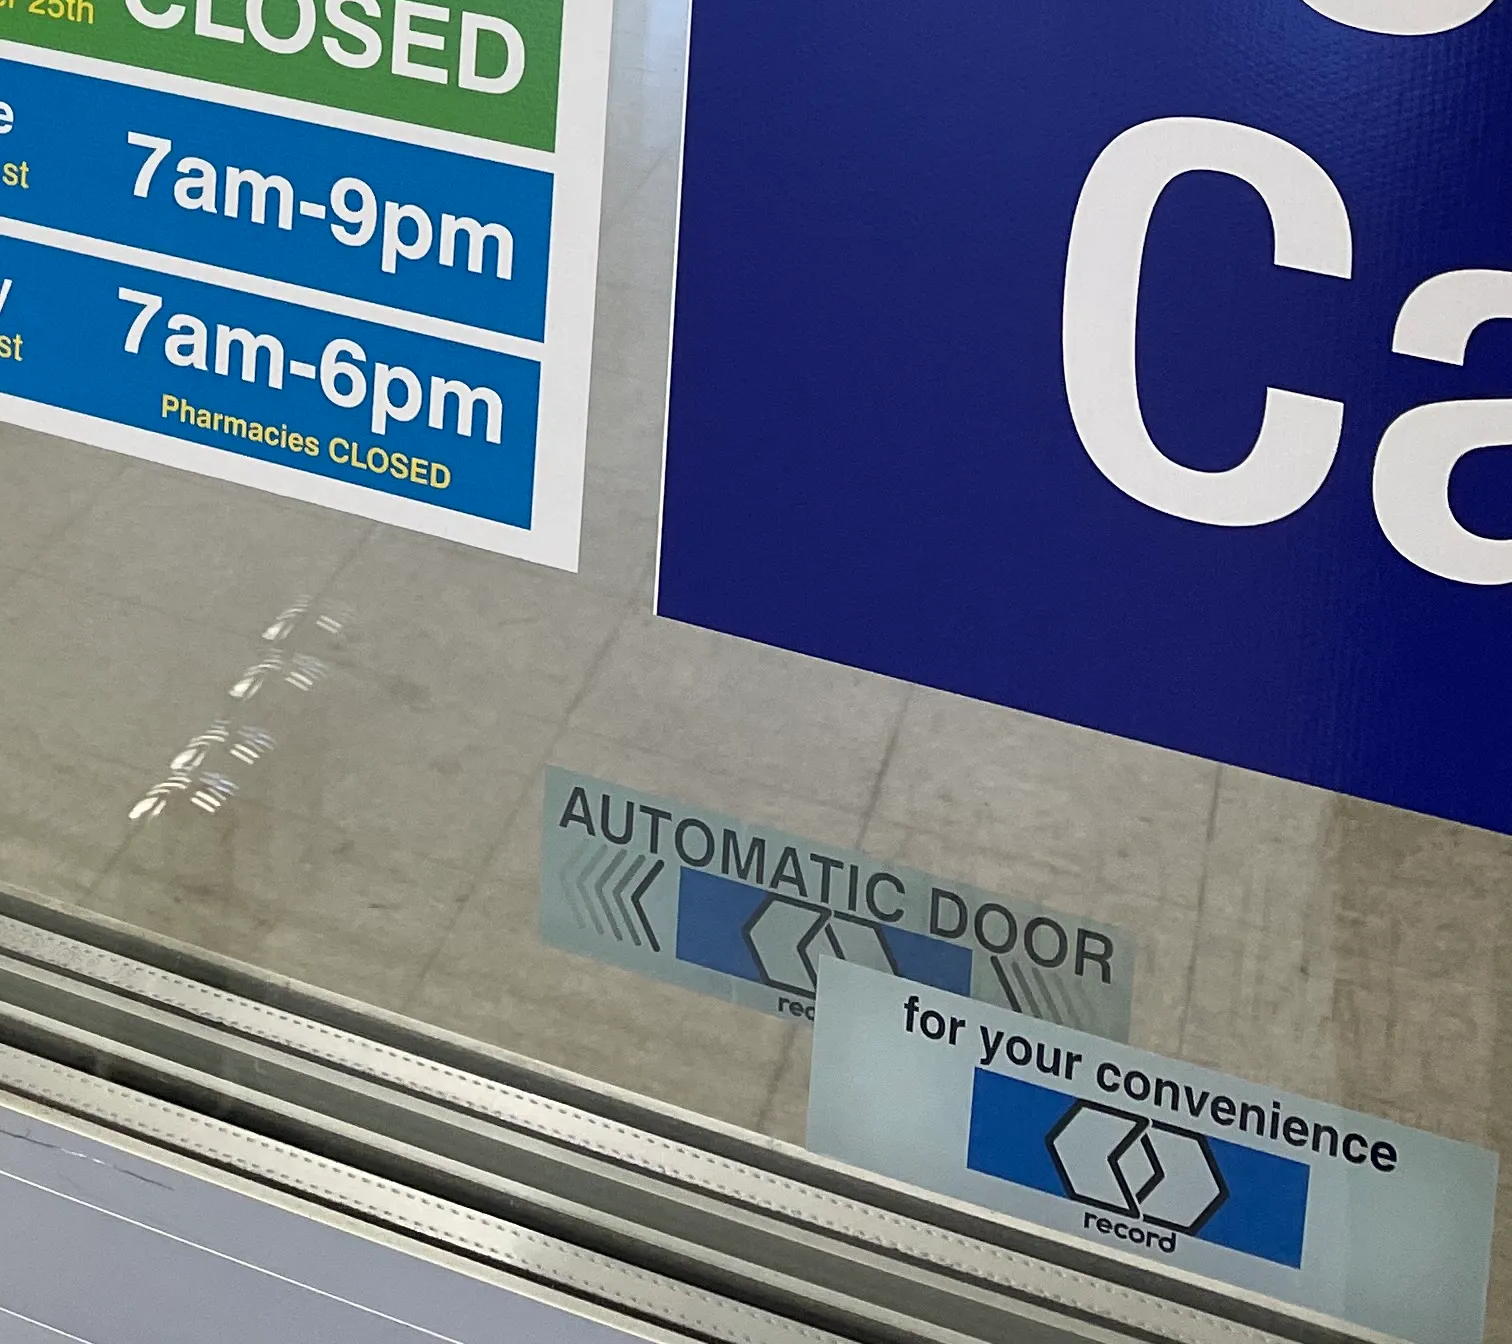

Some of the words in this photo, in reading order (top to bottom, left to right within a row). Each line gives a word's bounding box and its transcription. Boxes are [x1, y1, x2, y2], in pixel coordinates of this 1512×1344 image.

[128, 132, 513, 279] 7am-9pm
[119, 288, 502, 444] 7am-6pm
[163, 395, 319, 455] Pharmacies
[329, 438, 450, 488] CLOSED
[559, 787, 905, 922] AUTOMATIC
[930, 888, 1113, 984] DOOR
[778, 997, 815, 1021] rec
[904, 996, 965, 1045] for
[978, 1022, 1083, 1081] your
[1097, 1063, 1397, 1172] convenience
[1084, 1212, 1176, 1253] record
